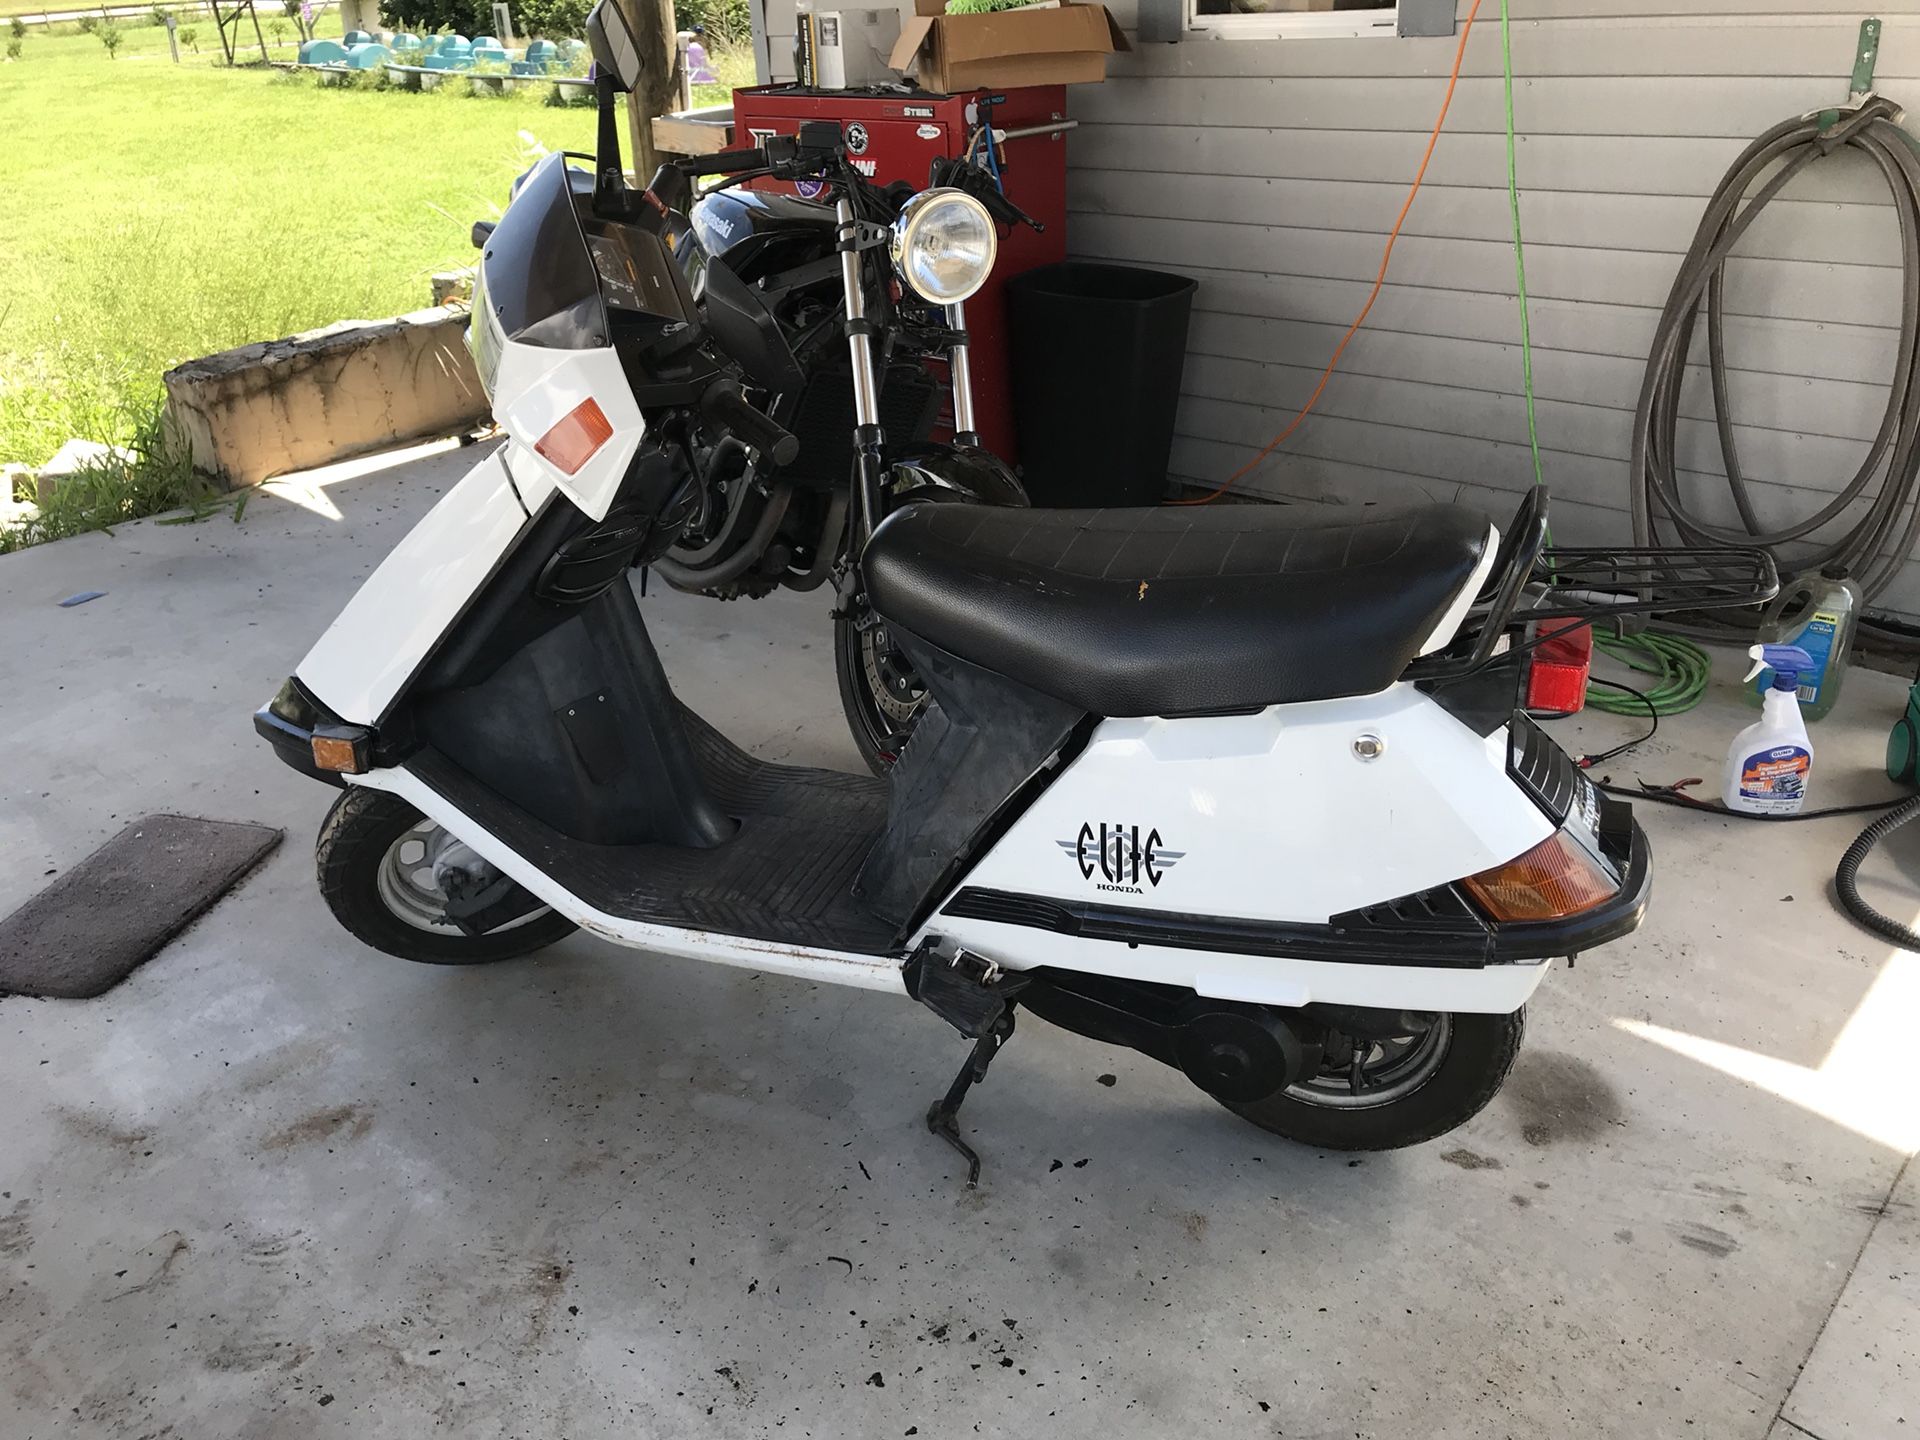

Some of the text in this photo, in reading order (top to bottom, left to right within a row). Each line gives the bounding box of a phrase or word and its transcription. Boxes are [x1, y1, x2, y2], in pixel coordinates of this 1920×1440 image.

[903, 106, 933, 117] STEEL
[1779, 761, 1801, 769] Cleaner
[1096, 883, 1144, 895] HONDA
